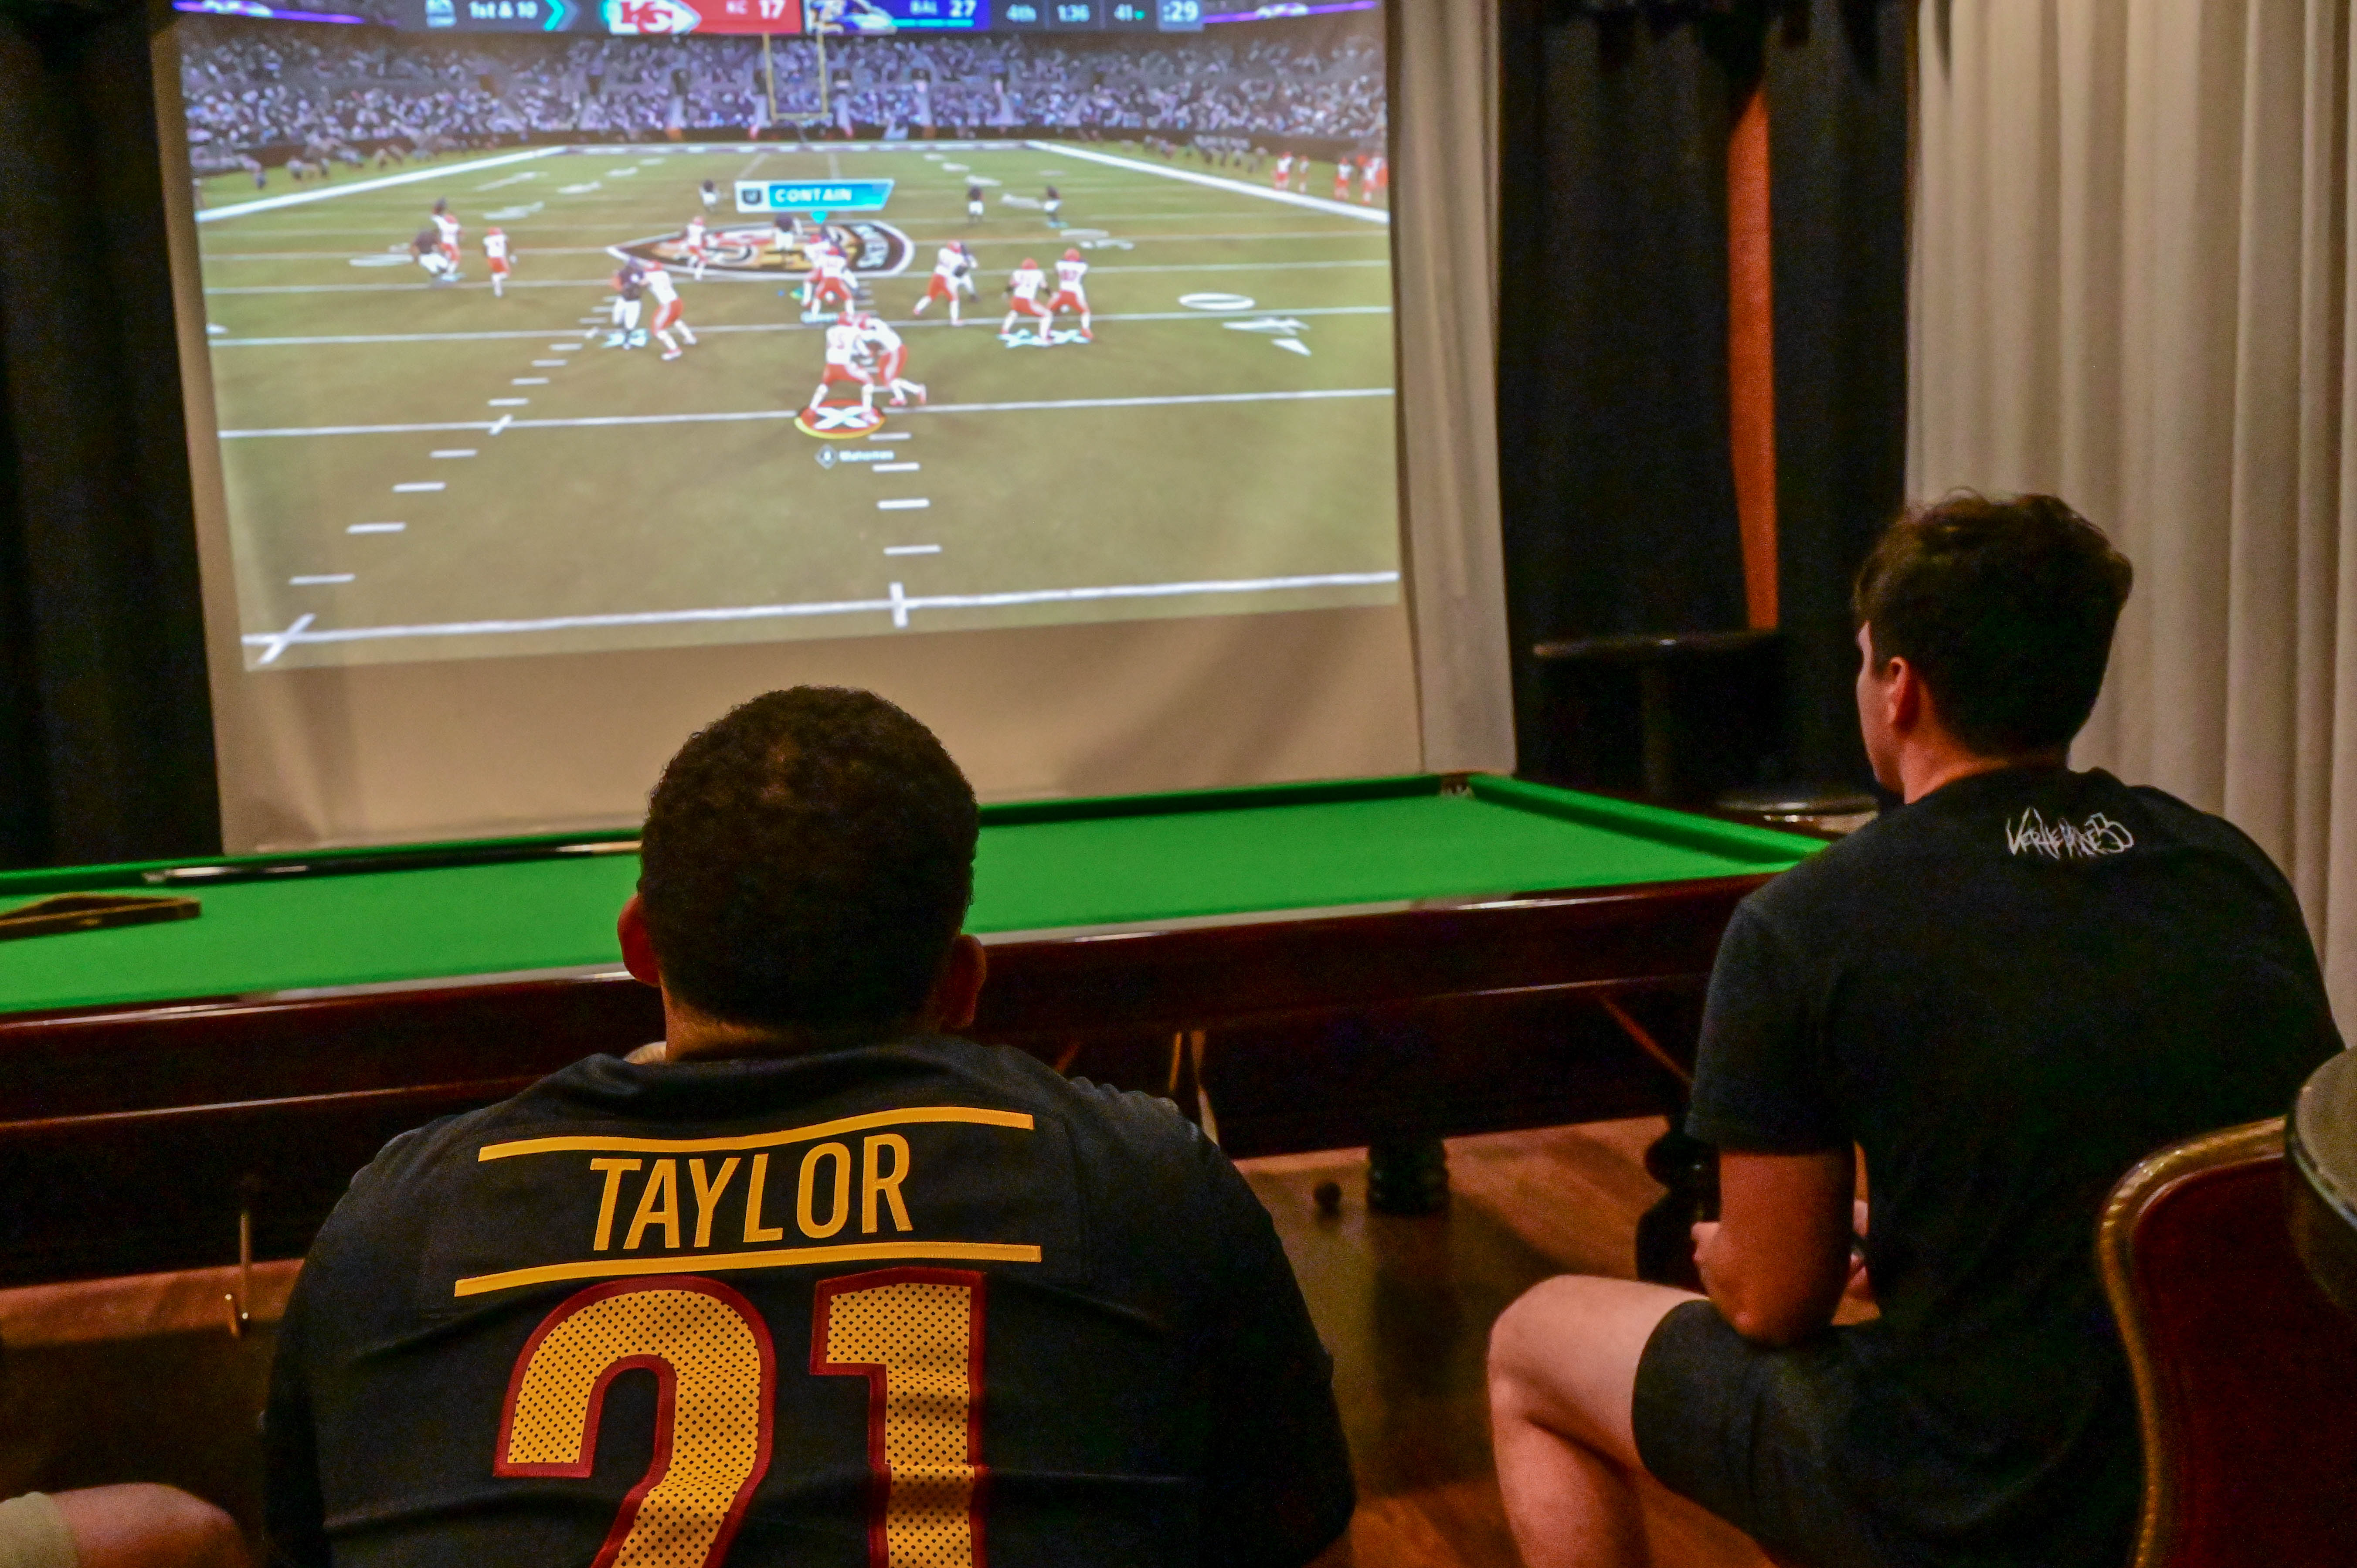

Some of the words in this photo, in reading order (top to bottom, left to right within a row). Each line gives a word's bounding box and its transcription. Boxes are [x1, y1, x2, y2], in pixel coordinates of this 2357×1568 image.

[759, 0, 785, 19] 17
[949, 0, 977, 17] 27
[775, 188, 852, 203] CONTAIN
[589, 1133, 914, 1251] TAYLOR
[492, 1266, 988, 1568] 21
